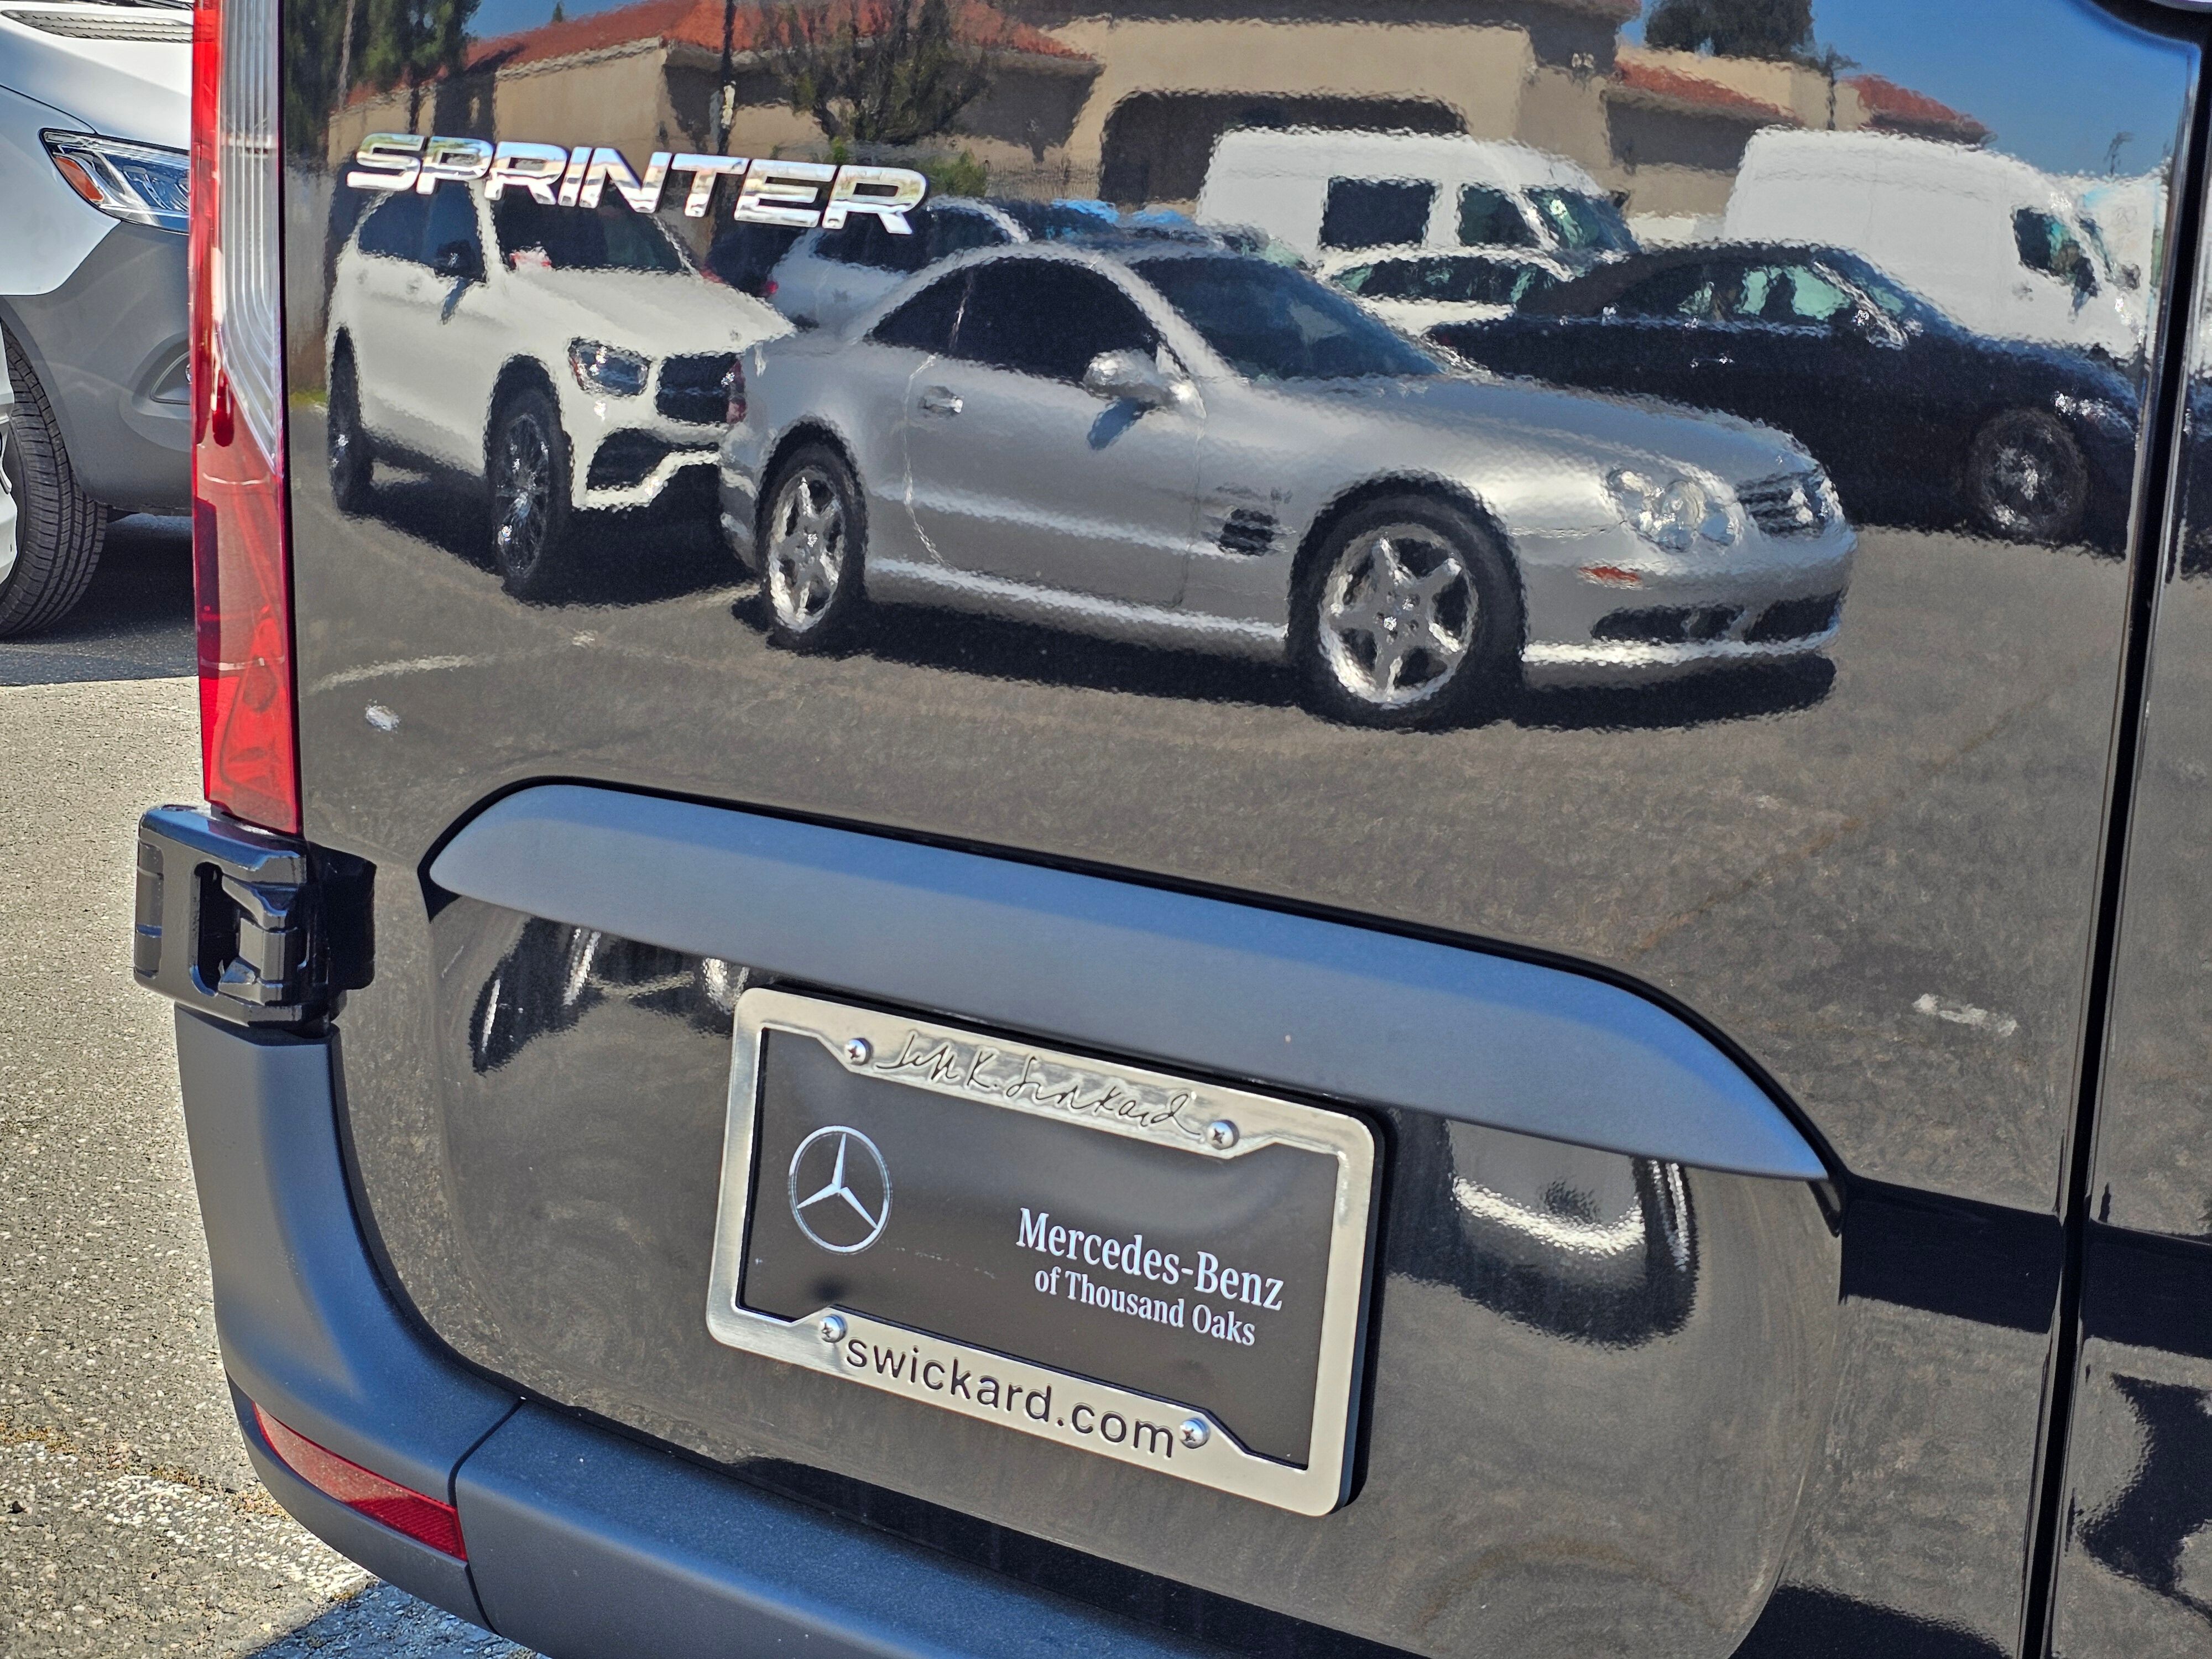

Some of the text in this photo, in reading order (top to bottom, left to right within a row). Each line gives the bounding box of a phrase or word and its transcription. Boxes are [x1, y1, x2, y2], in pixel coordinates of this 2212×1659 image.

[346, 132, 929, 235] SPRINTER
[1015, 1207, 1284, 1311] Mercedes-Benz
[1034, 1266, 1256, 1346] of Thousand Oaks
[846, 1337, 1174, 1460] swickard.com
